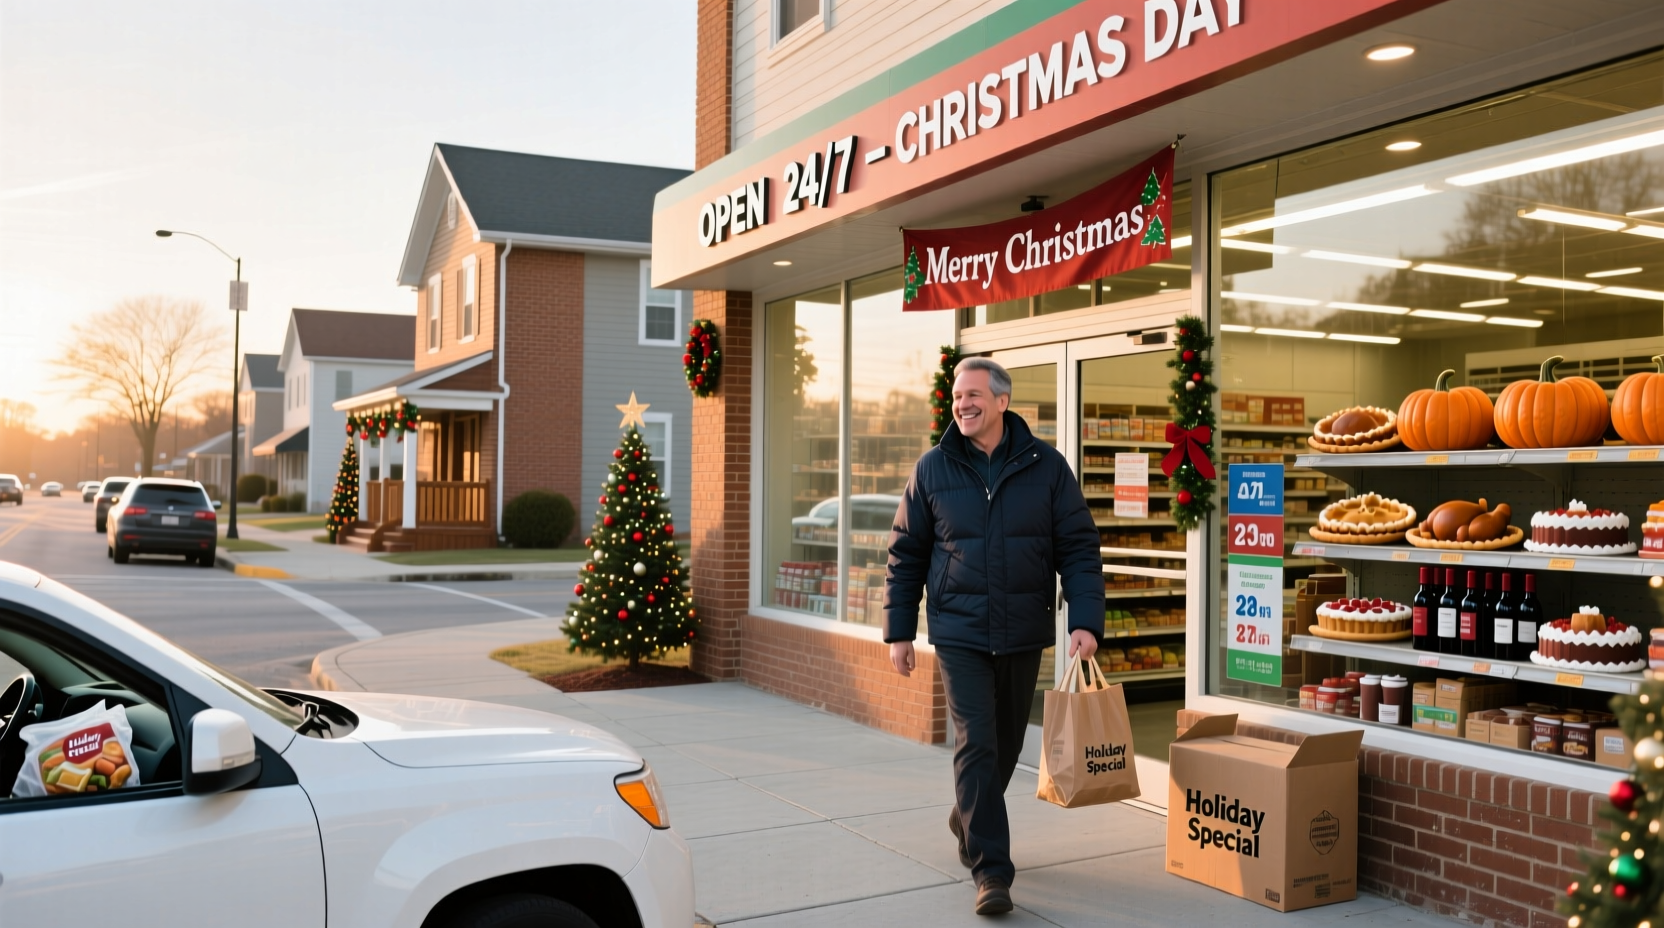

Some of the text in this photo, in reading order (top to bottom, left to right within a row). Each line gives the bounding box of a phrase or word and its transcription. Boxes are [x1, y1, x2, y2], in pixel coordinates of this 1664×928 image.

[698, 177, 769, 247] OPEN
[783, 134, 858, 215] 24/7
[895, 15, 1126, 163] CHRISTMAS
[924, 204, 1144, 290] Merry Christmas
[1086, 756, 1126, 776] Special
[1186, 788, 1265, 834] Holiday
[1188, 817, 1260, 858] Special
